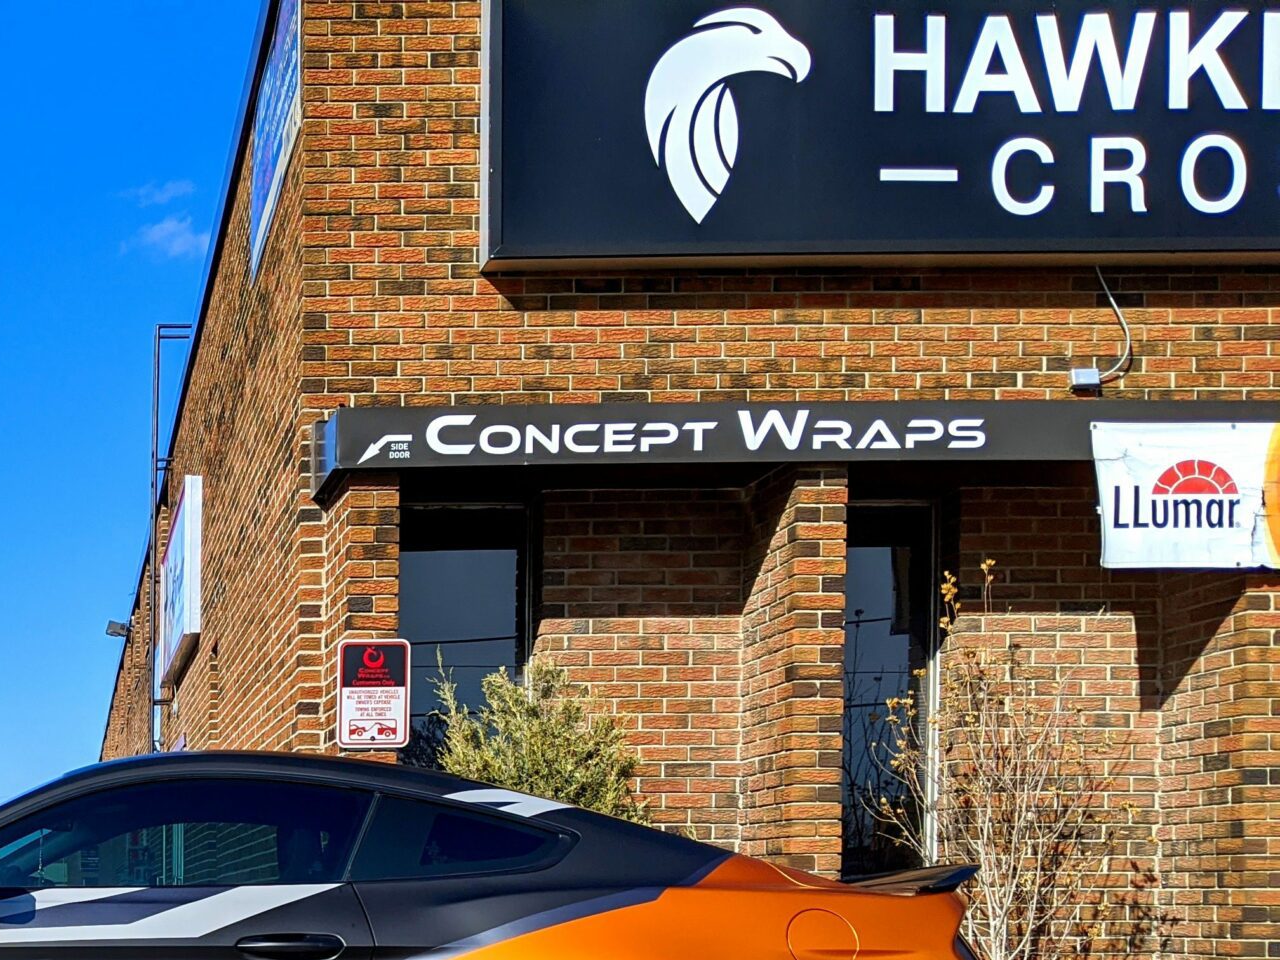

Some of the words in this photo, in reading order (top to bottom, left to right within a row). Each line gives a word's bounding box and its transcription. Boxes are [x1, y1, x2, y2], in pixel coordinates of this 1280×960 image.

[991, 133, 1280, 216] CRO
[425, 414, 719, 455] CONCEPT
[737, 409, 986, 451] WRAPS
[389, 451, 410, 459] DOOR
[1113, 485, 1241, 529] LLumar
